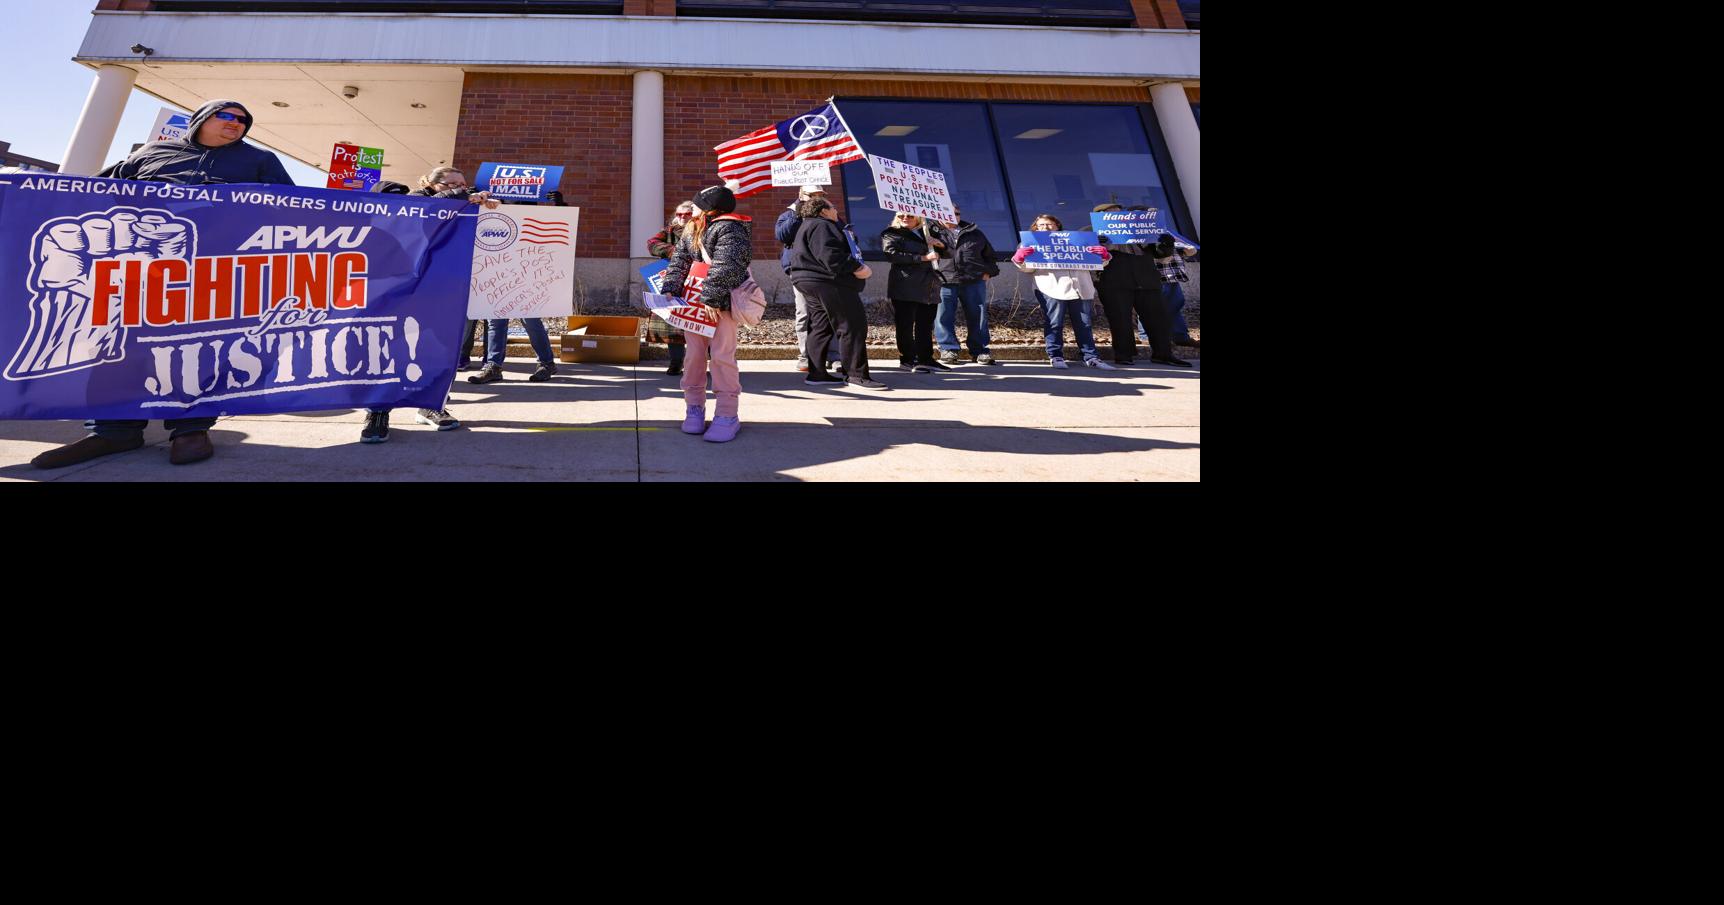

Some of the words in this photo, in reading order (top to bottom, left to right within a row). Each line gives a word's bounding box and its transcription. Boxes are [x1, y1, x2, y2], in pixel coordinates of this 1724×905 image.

[161, 127, 180, 138] US
[334, 146, 384, 165] Protest
[351, 162, 362, 171] is
[500, 168, 536, 178] U.S.
[773, 162, 801, 174] HANDS
[803, 162, 824, 171] OFF
[877, 157, 896, 168] THE
[902, 164, 944, 181] PEOPLES
[329, 169, 377, 184] Patriotic
[879, 174, 904, 186] POST
[912, 182, 945, 196] OFFICE
[19, 177, 136, 196] AMERICAN
[143, 185, 224, 202] POSTAL
[230, 191, 326, 210] WORKERS
[332, 200, 392, 217] UNION,
[495, 185, 533, 195] MAIL
[891, 185, 939, 203] NATIONAL
[884, 200, 894, 209] IS
[898, 204, 917, 214] NOT
[921, 209, 928, 217] 4
[930, 210, 954, 222] SALE
[892, 193, 943, 212] TREASURE
[1102, 212, 1137, 221] Hands
[1139, 211, 1157, 220] off!
[235, 225, 372, 251] APWU
[1054, 245, 1093, 253] PUBLIC
[472, 252, 513, 275] SAVE
[515, 246, 546, 258] THE
[534, 265, 554, 279] IT'S
[91, 251, 369, 328] FIGHTING
[247, 296, 328, 336] for
[684, 321, 705, 333] NOW!
[144, 316, 423, 397] JUSTICE!
